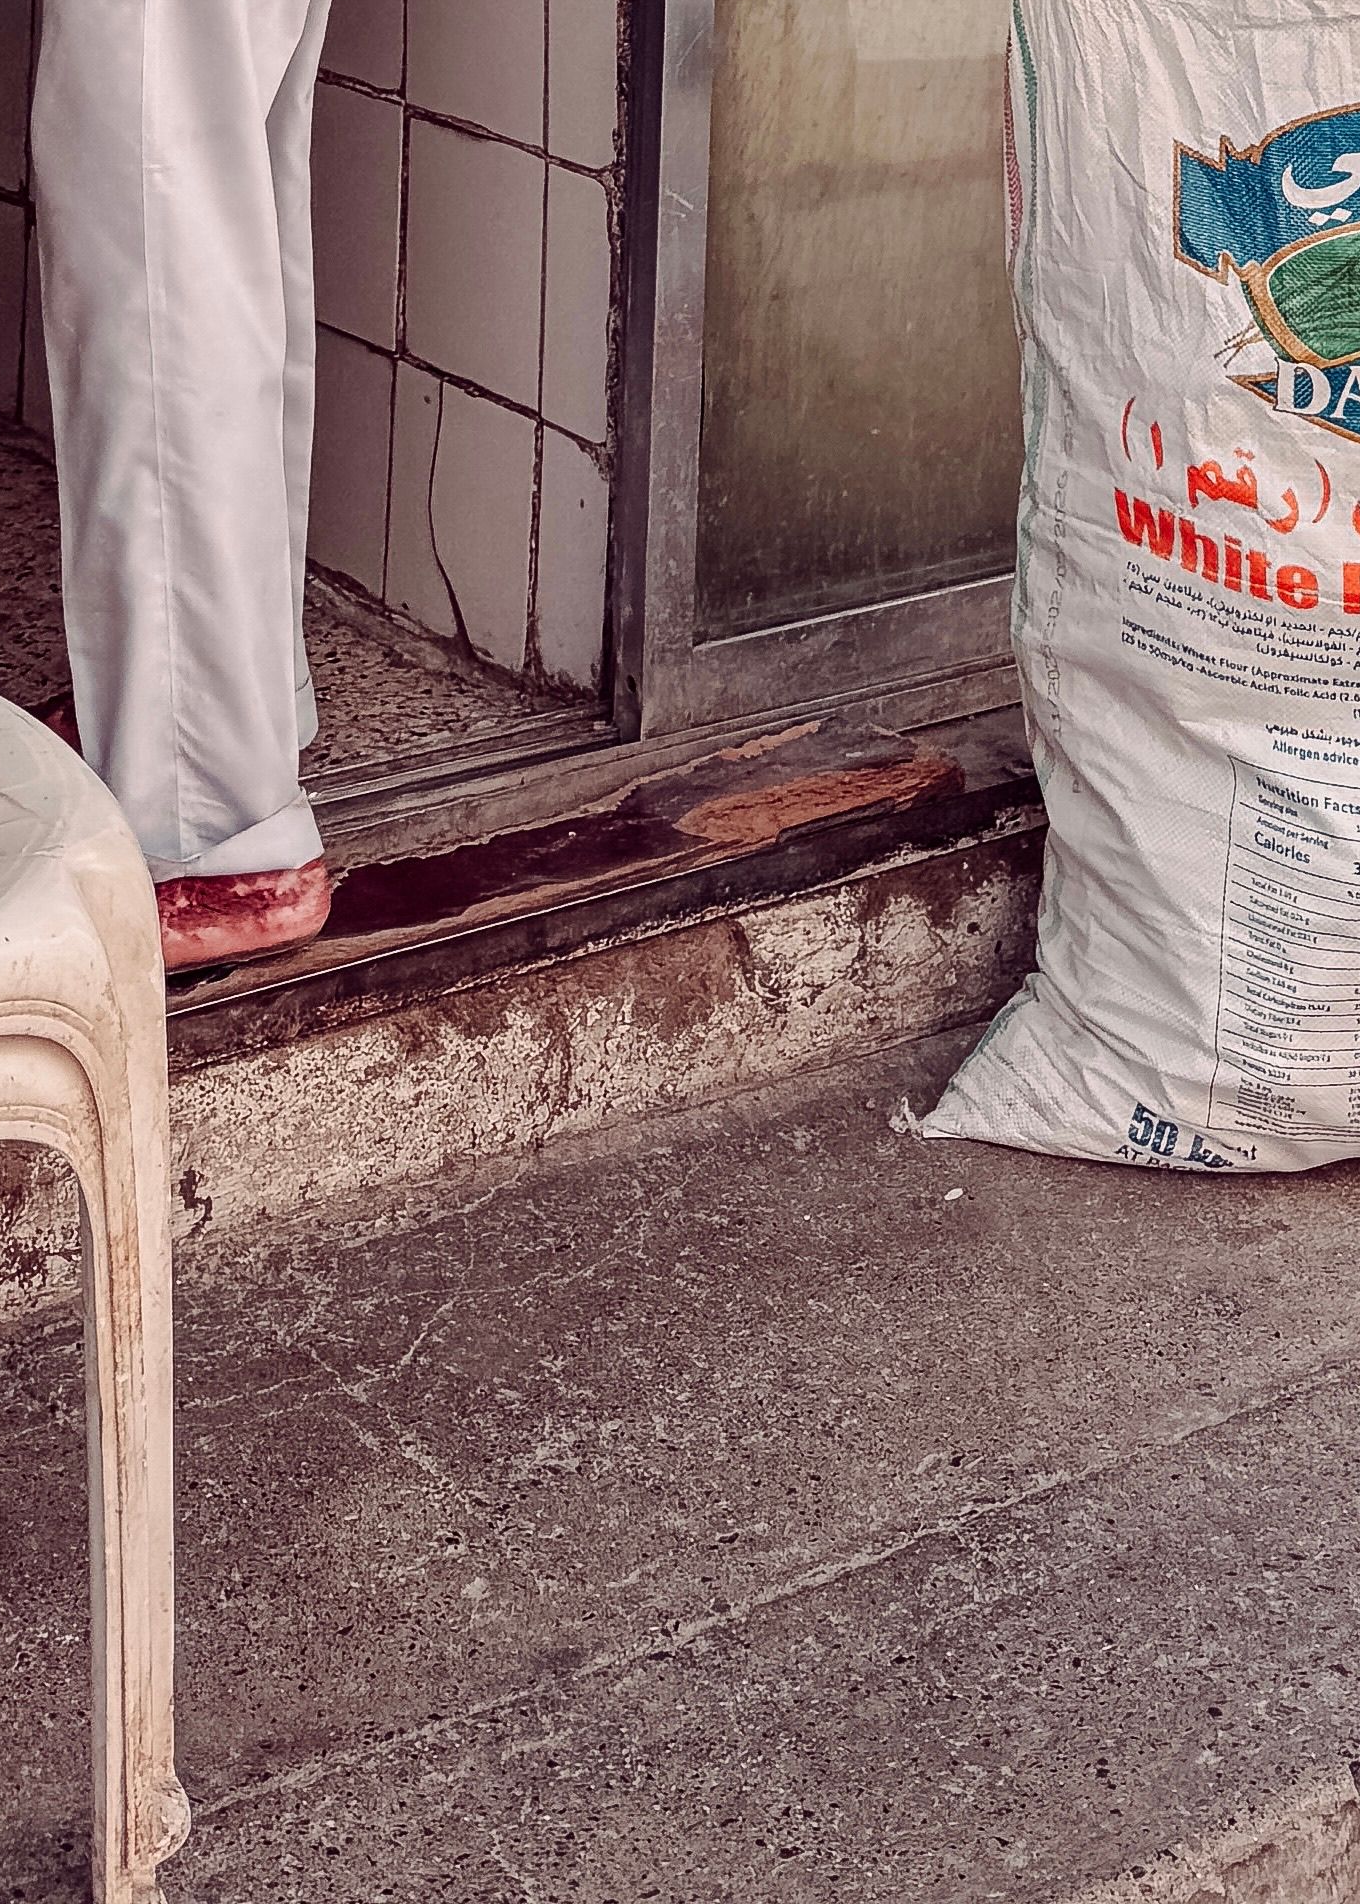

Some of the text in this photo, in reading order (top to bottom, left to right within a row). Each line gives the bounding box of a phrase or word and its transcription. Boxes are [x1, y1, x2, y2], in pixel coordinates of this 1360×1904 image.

[1113, 486, 1320, 611] White
[1219, 657, 1249, 673] Flour
[1251, 665, 1330, 686] (Approximate
[1311, 690, 1337, 701] Acid
[1272, 739, 1321, 761] Allergen
[1256, 775, 1320, 809] Nutrition
[1253, 830, 1312, 865] Calories
[1127, 1102, 1180, 1157] 50
